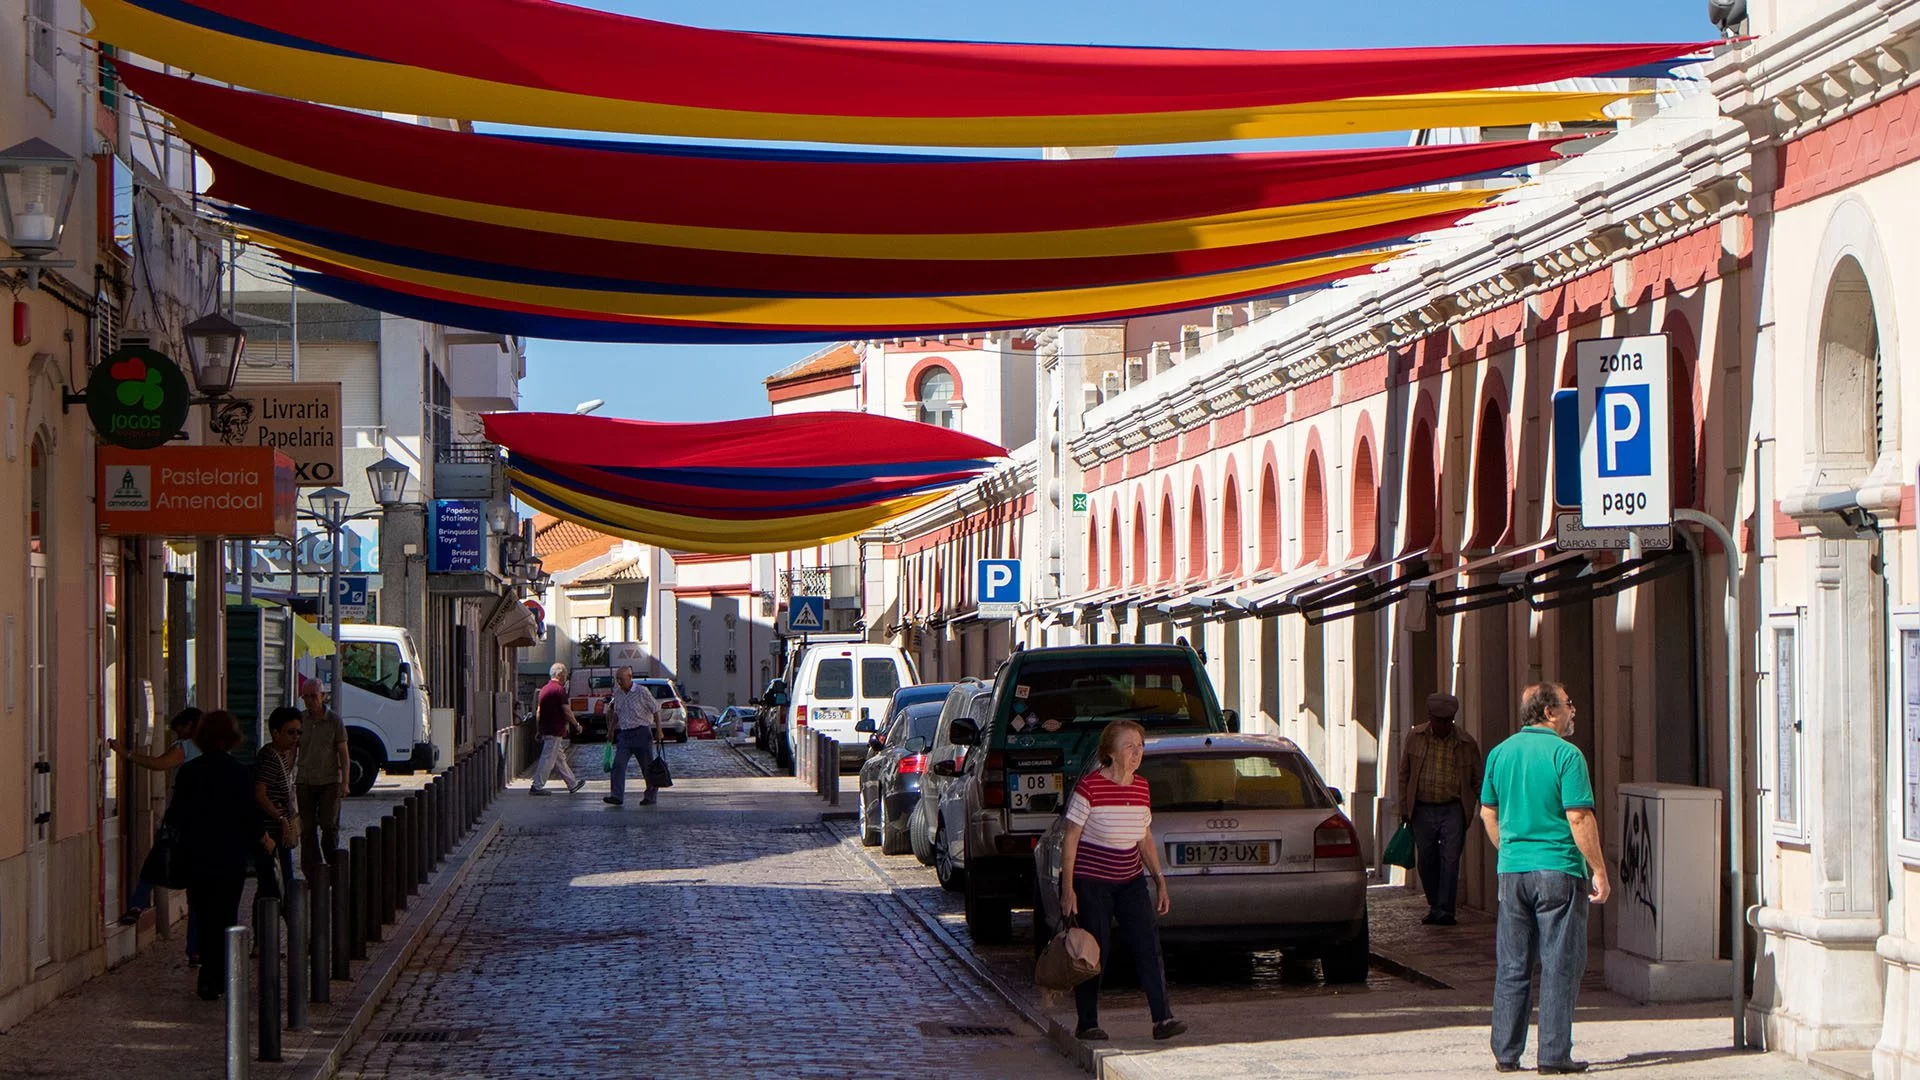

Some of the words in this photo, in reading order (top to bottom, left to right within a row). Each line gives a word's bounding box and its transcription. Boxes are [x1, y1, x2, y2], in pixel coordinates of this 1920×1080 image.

[1599, 352, 1643, 373] zona
[262, 397, 329, 419] Livraria
[111, 412, 161, 433] JOGOS
[1604, 392, 1641, 471] P
[258, 426, 334, 449] Papelaria
[161, 467, 259, 486] Pastelaria
[156, 492, 263, 510] Amendoal
[1602, 491, 1647, 515] pago
[441, 514, 479, 523] Stationery
[445, 507, 479, 515] Papelaria
[438, 528, 478, 536] Brinquedos
[439, 536, 457, 544] Toys
[1560, 540, 1597, 548] CARGAS
[1602, 540, 1610, 548] E
[1614, 539, 1669, 548] DESARGAS
[451, 556, 471, 564] Gifts
[986, 564, 1013, 599] P
[1027, 775, 1046, 790] 08
